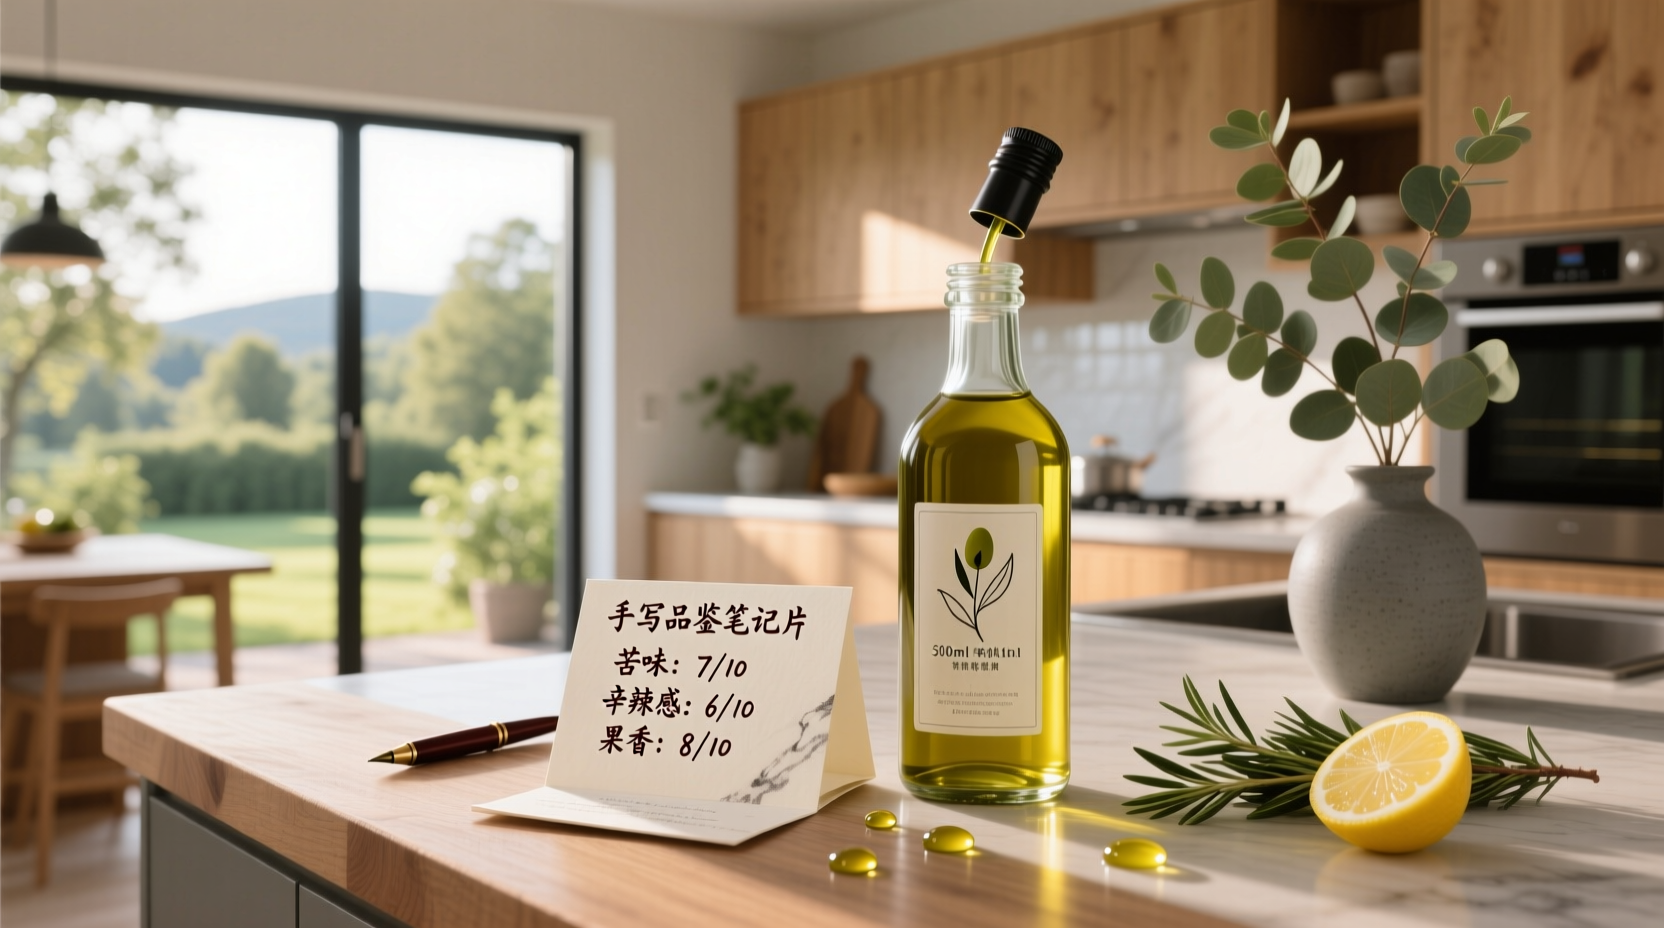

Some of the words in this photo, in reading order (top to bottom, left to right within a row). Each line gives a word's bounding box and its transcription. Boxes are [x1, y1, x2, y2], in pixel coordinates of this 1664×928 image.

[607, 599, 807, 641] 手写品鉴笔记片
